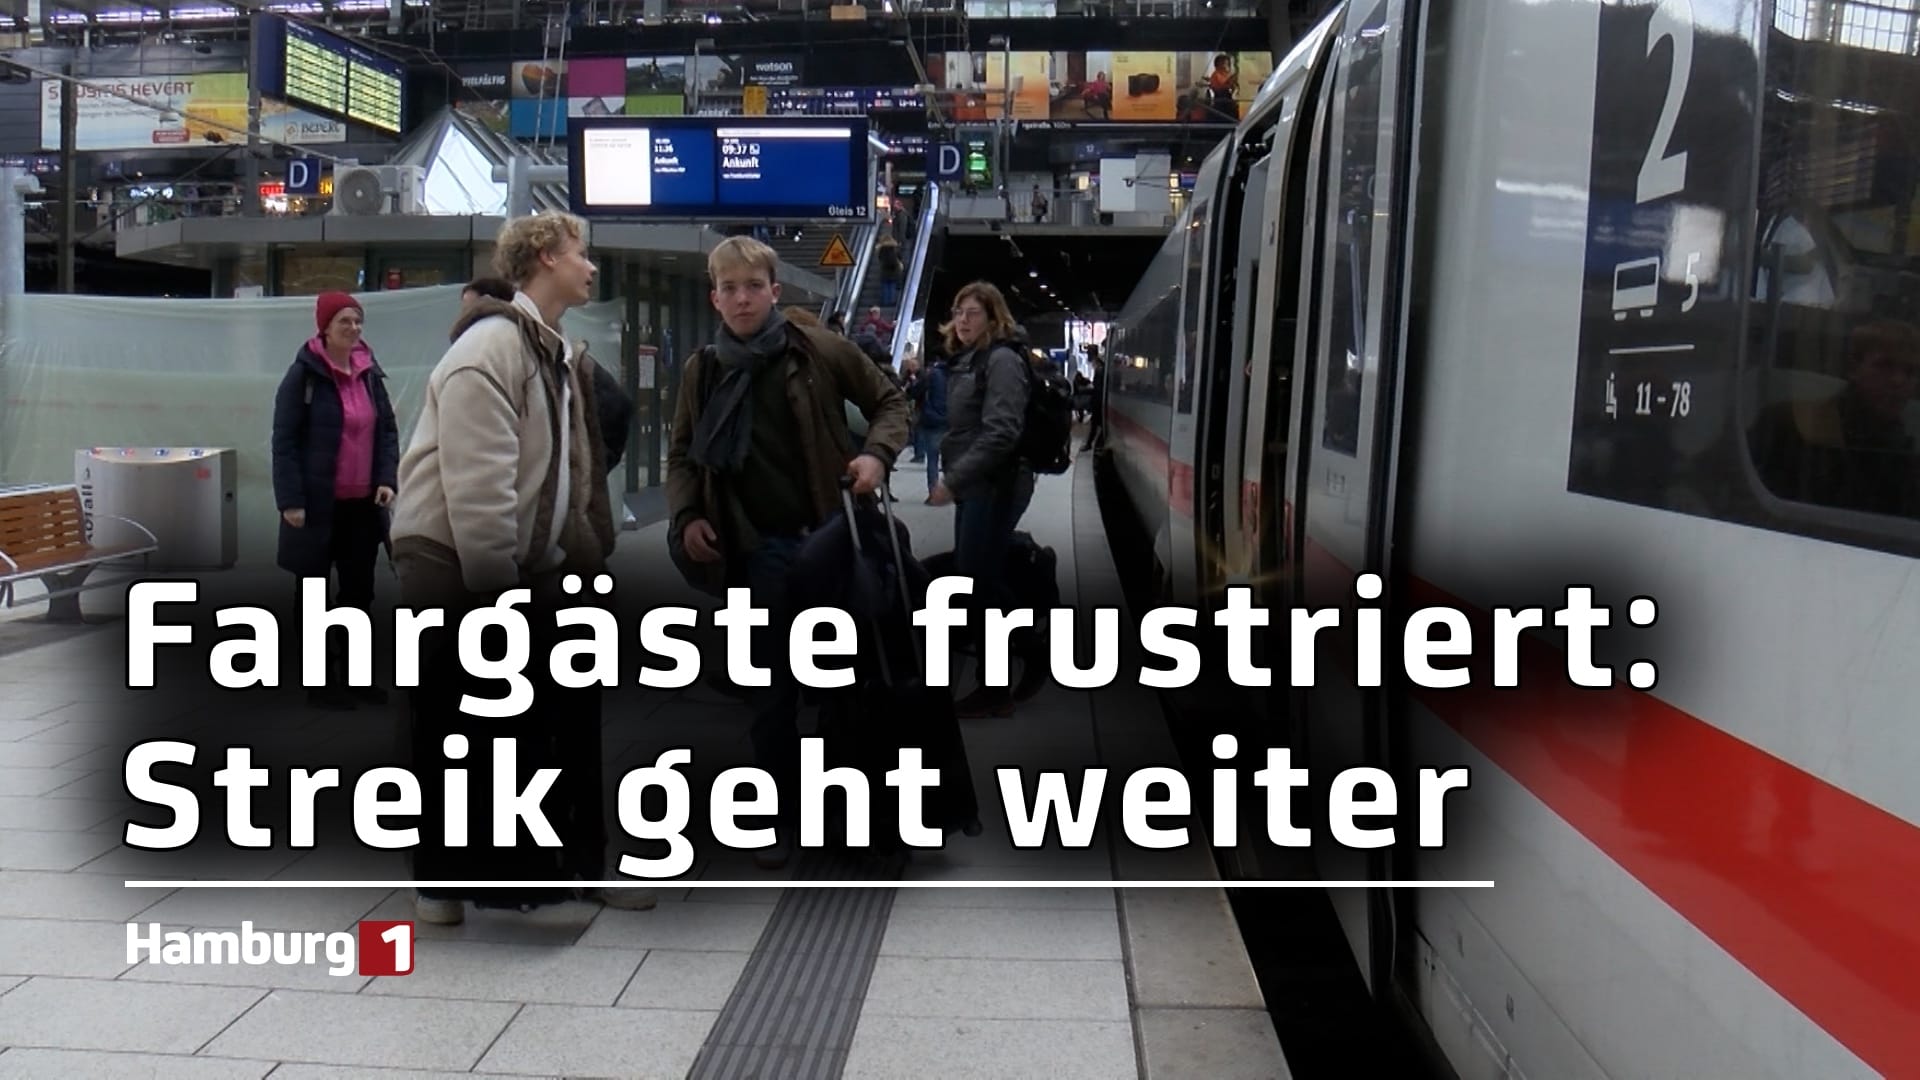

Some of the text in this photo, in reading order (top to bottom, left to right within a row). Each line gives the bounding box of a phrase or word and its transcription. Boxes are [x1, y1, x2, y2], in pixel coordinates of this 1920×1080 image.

[755, 62, 793, 72] watson
[131, 81, 194, 95] HEVERT
[1636, 0, 1695, 204] 2
[722, 156, 759, 168] Ankunft
[939, 145, 960, 174] D
[289, 160, 308, 188] D
[856, 206, 866, 216] 12
[1681, 252, 1700, 313] 5
[1670, 381, 1691, 417] 78
